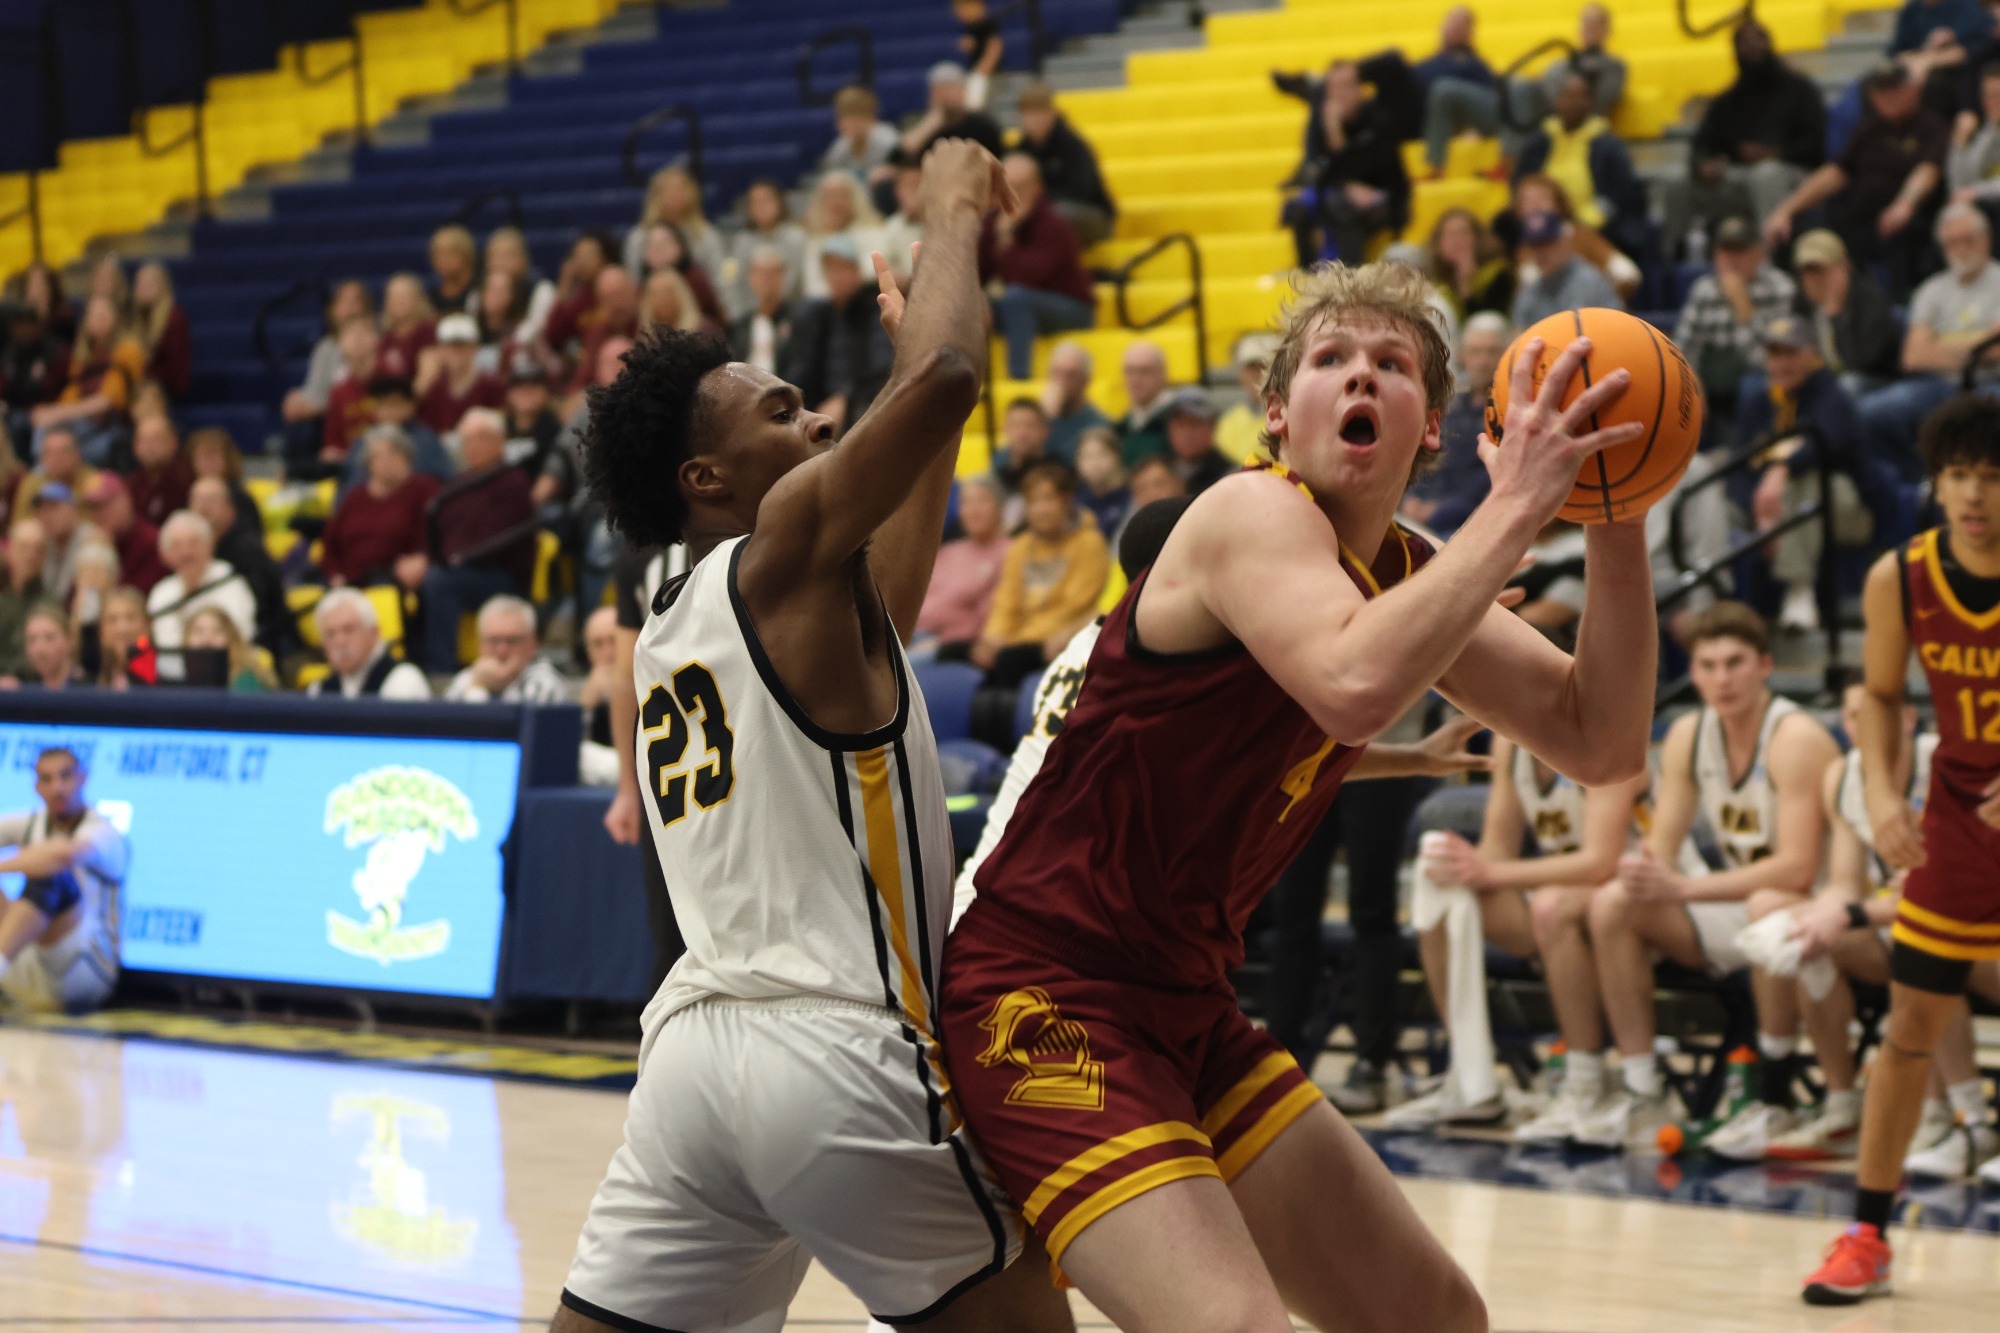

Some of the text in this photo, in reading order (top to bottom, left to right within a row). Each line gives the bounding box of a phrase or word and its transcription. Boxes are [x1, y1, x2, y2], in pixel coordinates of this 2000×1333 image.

[642, 659, 735, 828] 23
[1957, 687, 2000, 743] 12
[1278, 735, 1337, 823] 4
